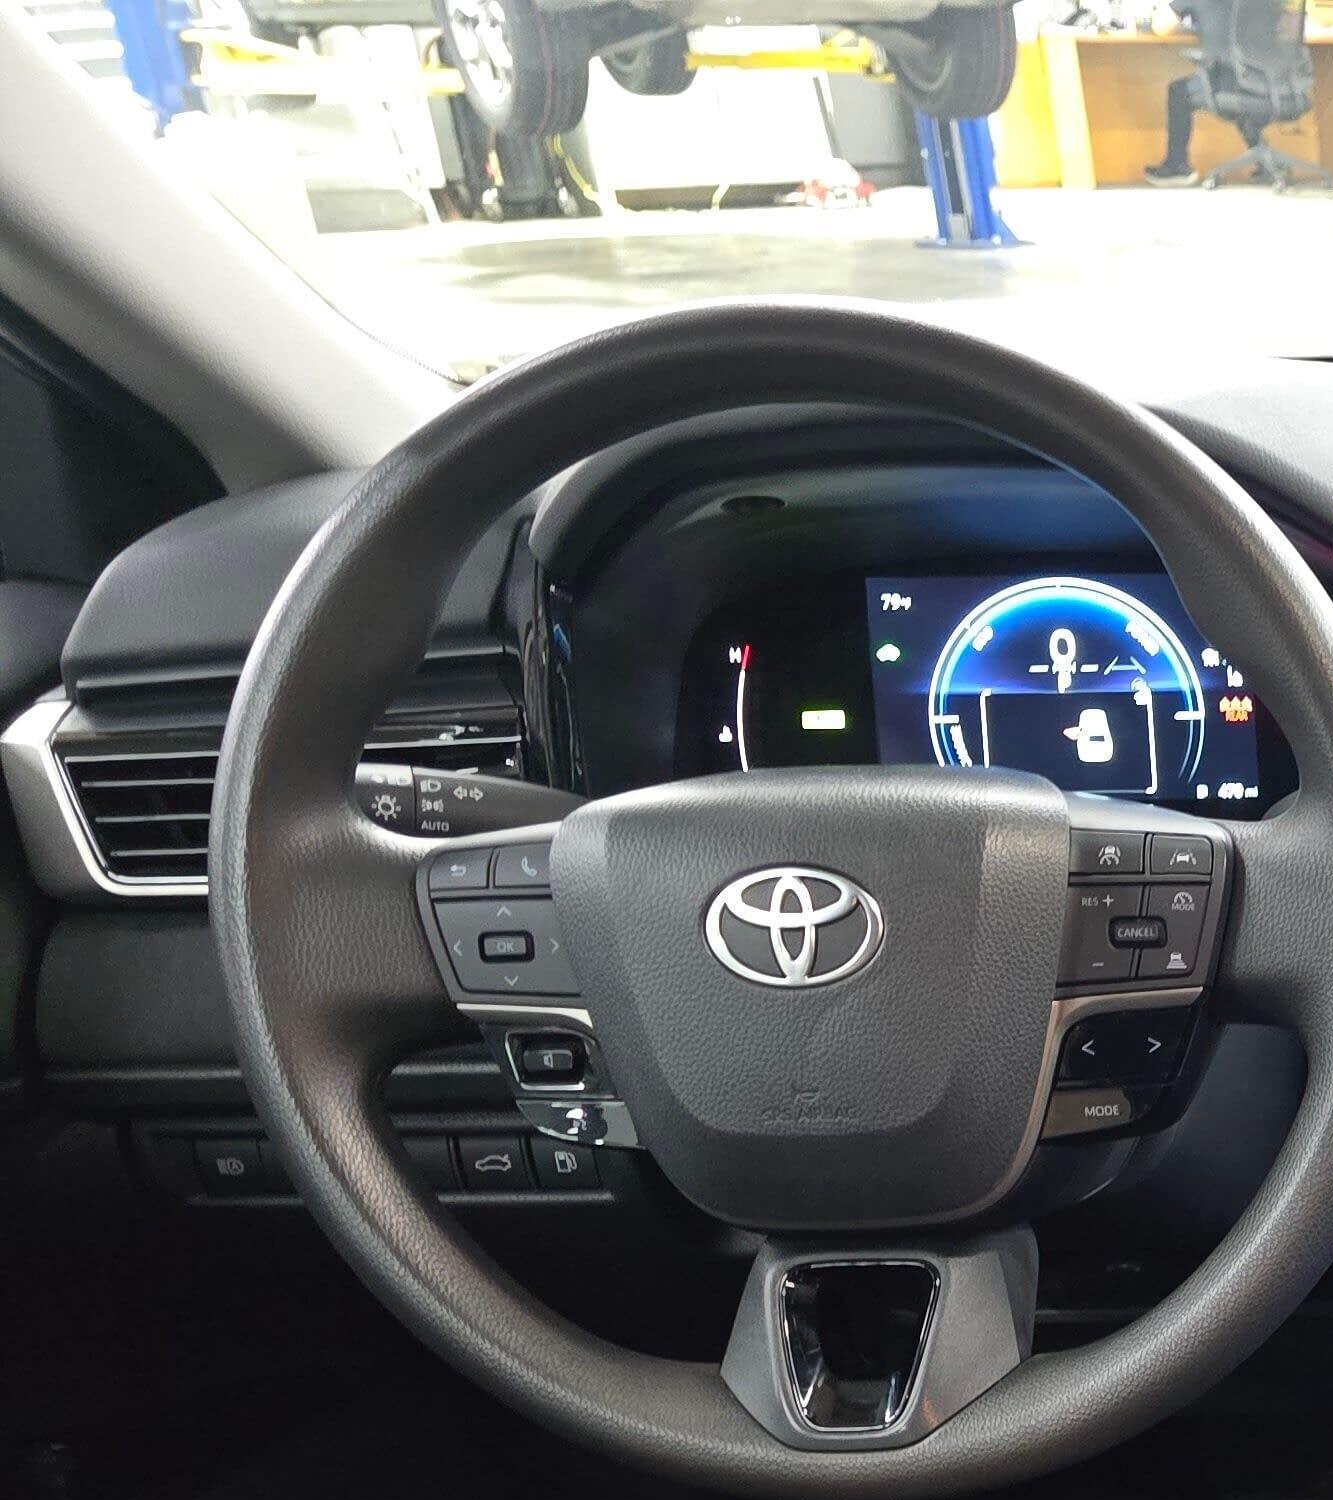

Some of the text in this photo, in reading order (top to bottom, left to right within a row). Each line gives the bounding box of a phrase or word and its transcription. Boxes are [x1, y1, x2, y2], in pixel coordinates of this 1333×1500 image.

[421, 820, 450, 832] AUTO
[1081, 896, 1099, 907] RES
[1171, 903, 1195, 911] MODE
[1117, 927, 1154, 938] CANCEL
[496, 942, 514, 953] OK
[1084, 1105, 1119, 1117] MODE
